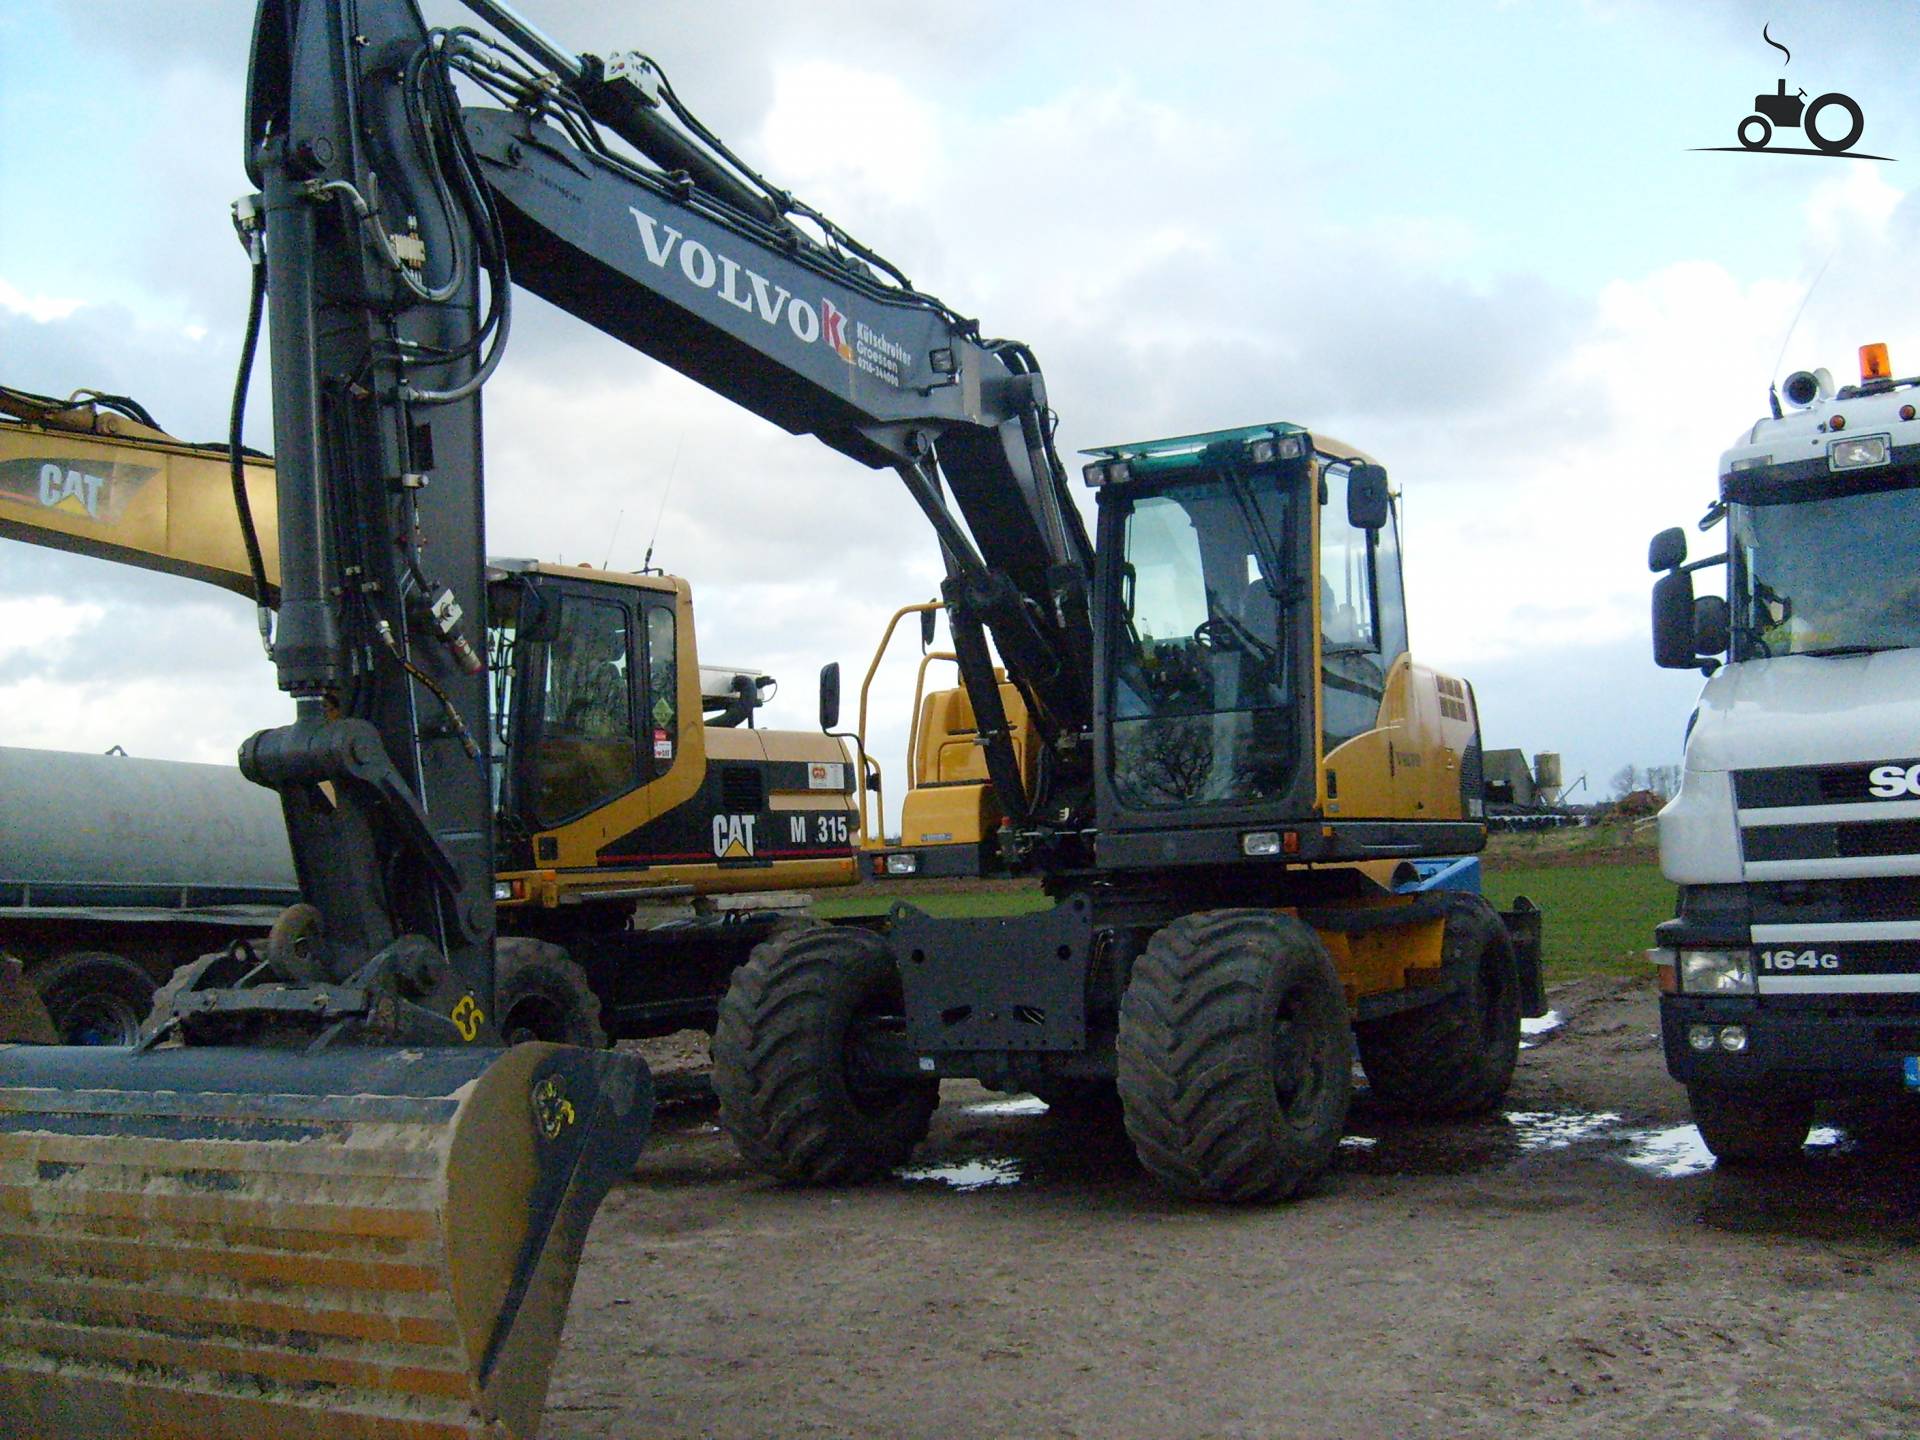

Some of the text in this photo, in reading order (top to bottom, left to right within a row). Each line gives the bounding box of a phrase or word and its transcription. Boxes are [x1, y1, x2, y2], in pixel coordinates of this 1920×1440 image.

[629, 206, 819, 343] VOLVO
[39, 463, 103, 520] CAT
[712, 814, 756, 858] CAT
[790, 816, 847, 843] M 315
